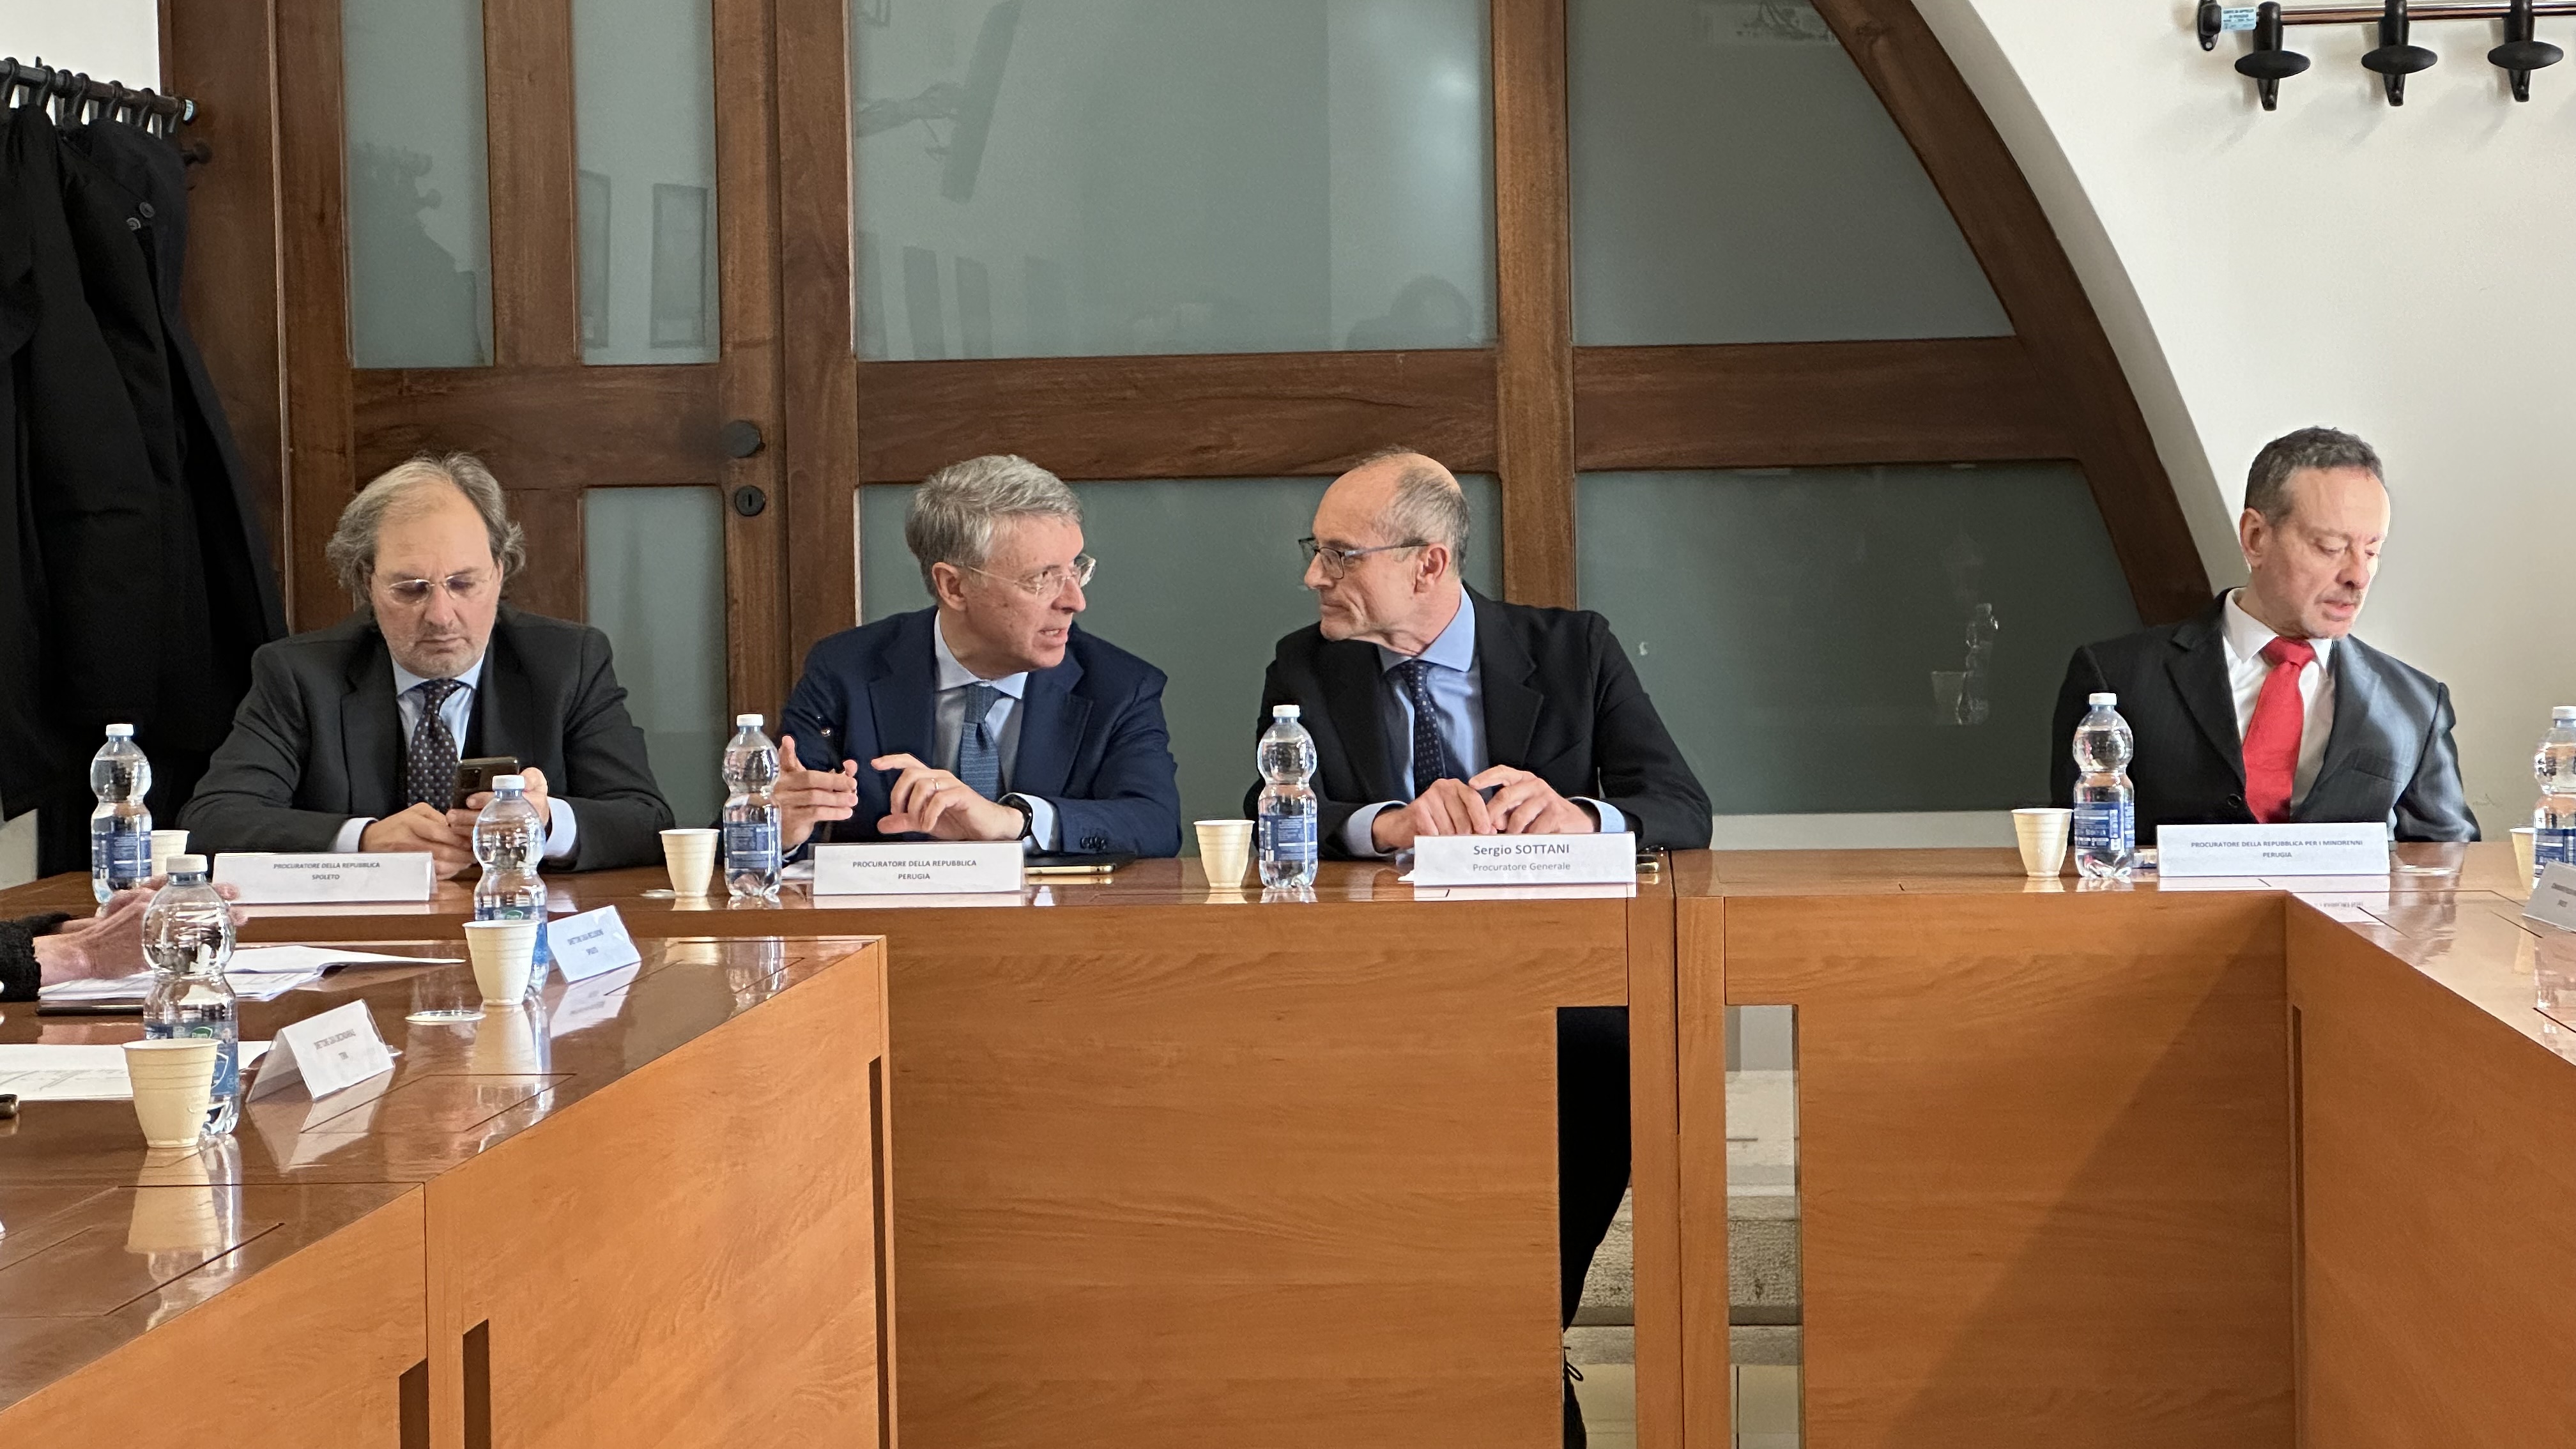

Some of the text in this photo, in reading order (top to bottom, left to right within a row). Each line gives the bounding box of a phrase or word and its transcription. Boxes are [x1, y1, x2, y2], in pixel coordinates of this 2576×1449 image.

[1473, 843, 1570, 857] Sergio SOTTANI
[1472, 862, 1571, 872] Procuratore Generale
